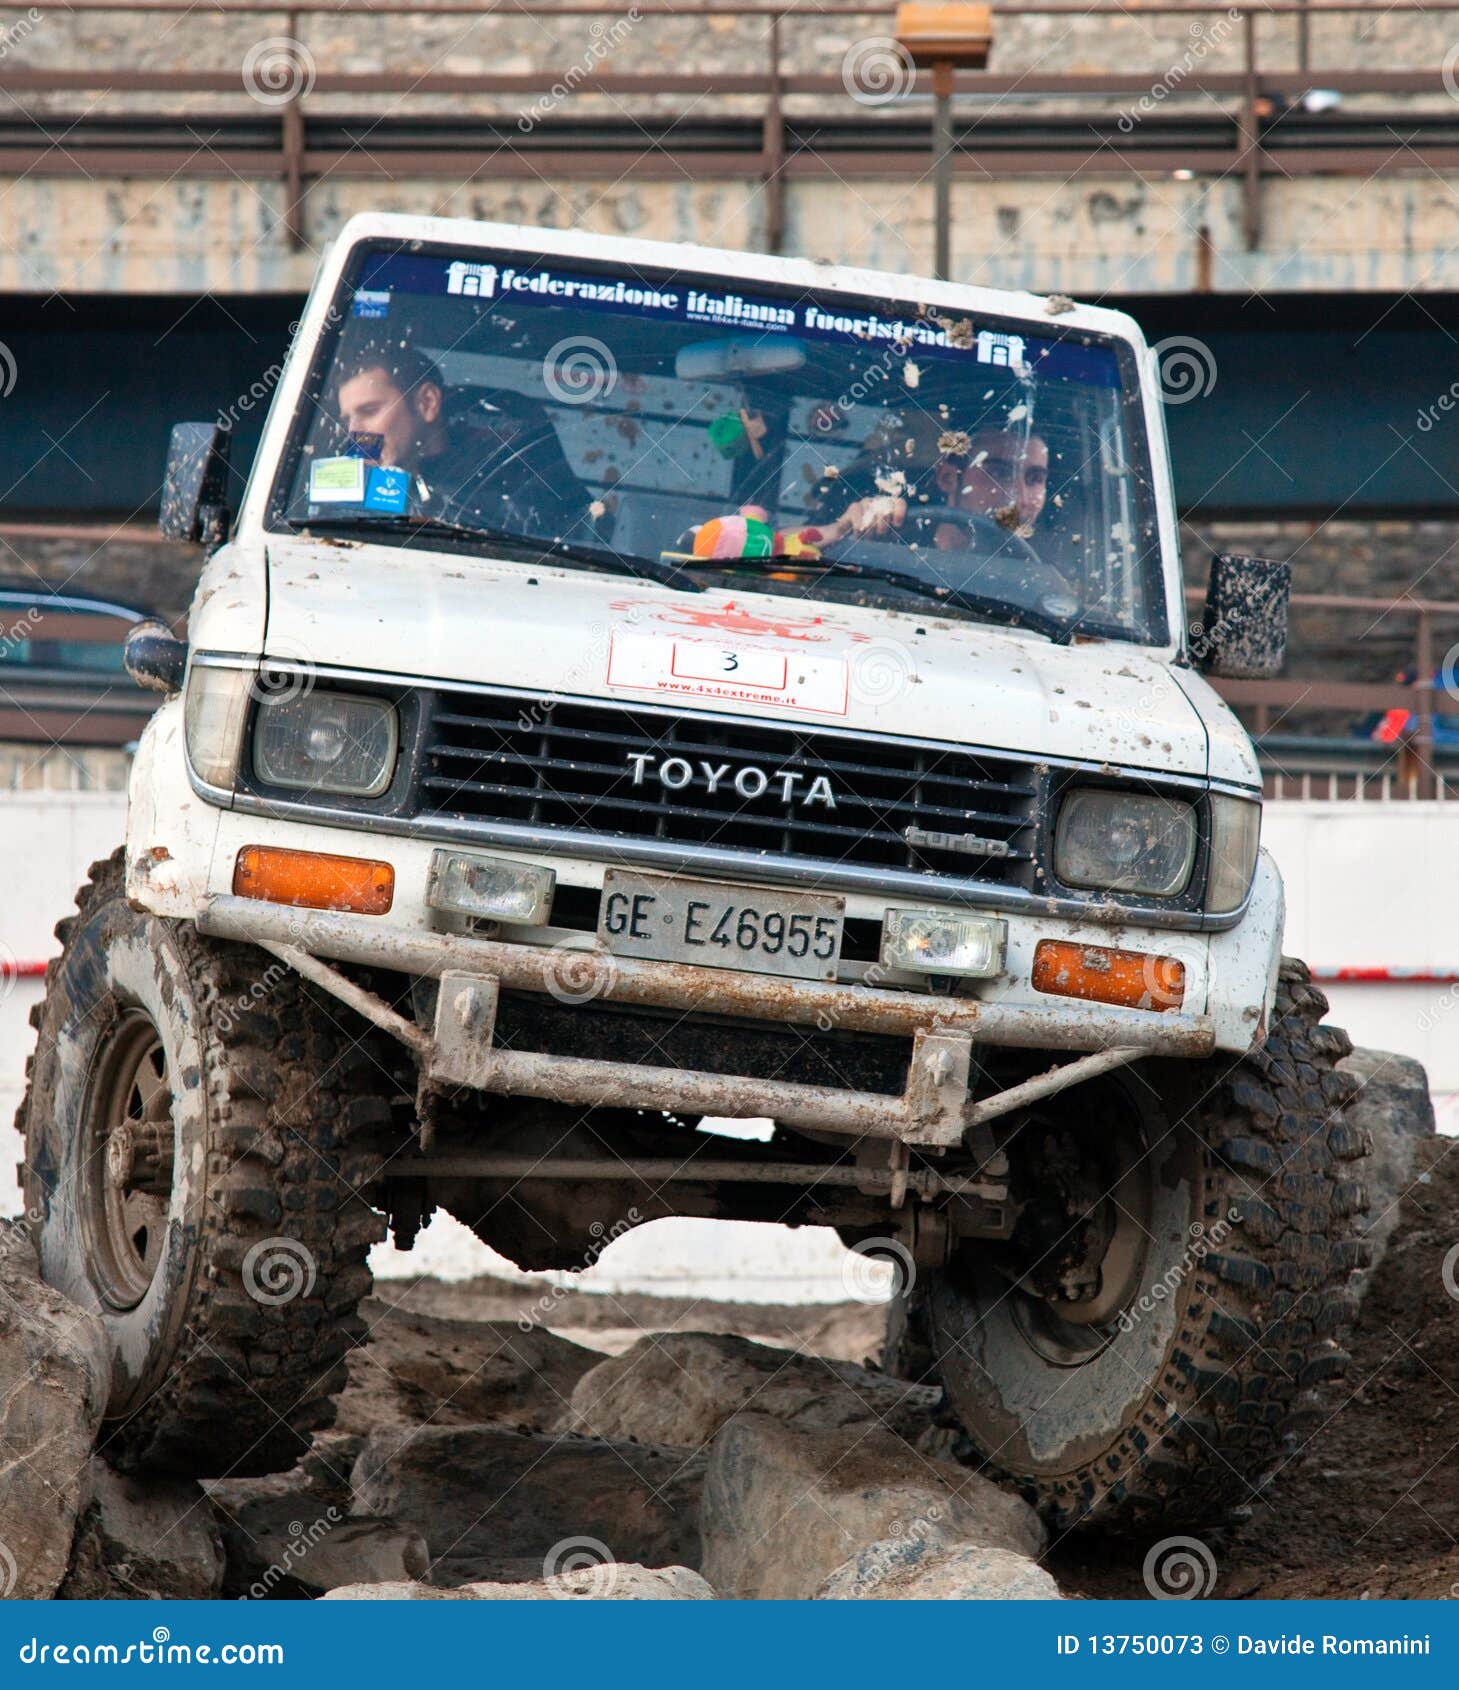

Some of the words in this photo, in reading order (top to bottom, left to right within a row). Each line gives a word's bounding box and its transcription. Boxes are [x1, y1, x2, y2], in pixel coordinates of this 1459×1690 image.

[501, 268, 678, 309] federazione
[686, 290, 794, 326] italiana
[805, 307, 973, 350] fuoristrad
[721, 651, 738, 671] 3
[656, 680, 797, 705] www.4x4extreme.it
[627, 753, 837, 808] TOYOTA
[905, 826, 1009, 857] turbo
[606, 892, 655, 939] GE
[685, 901, 837, 959] E46955
